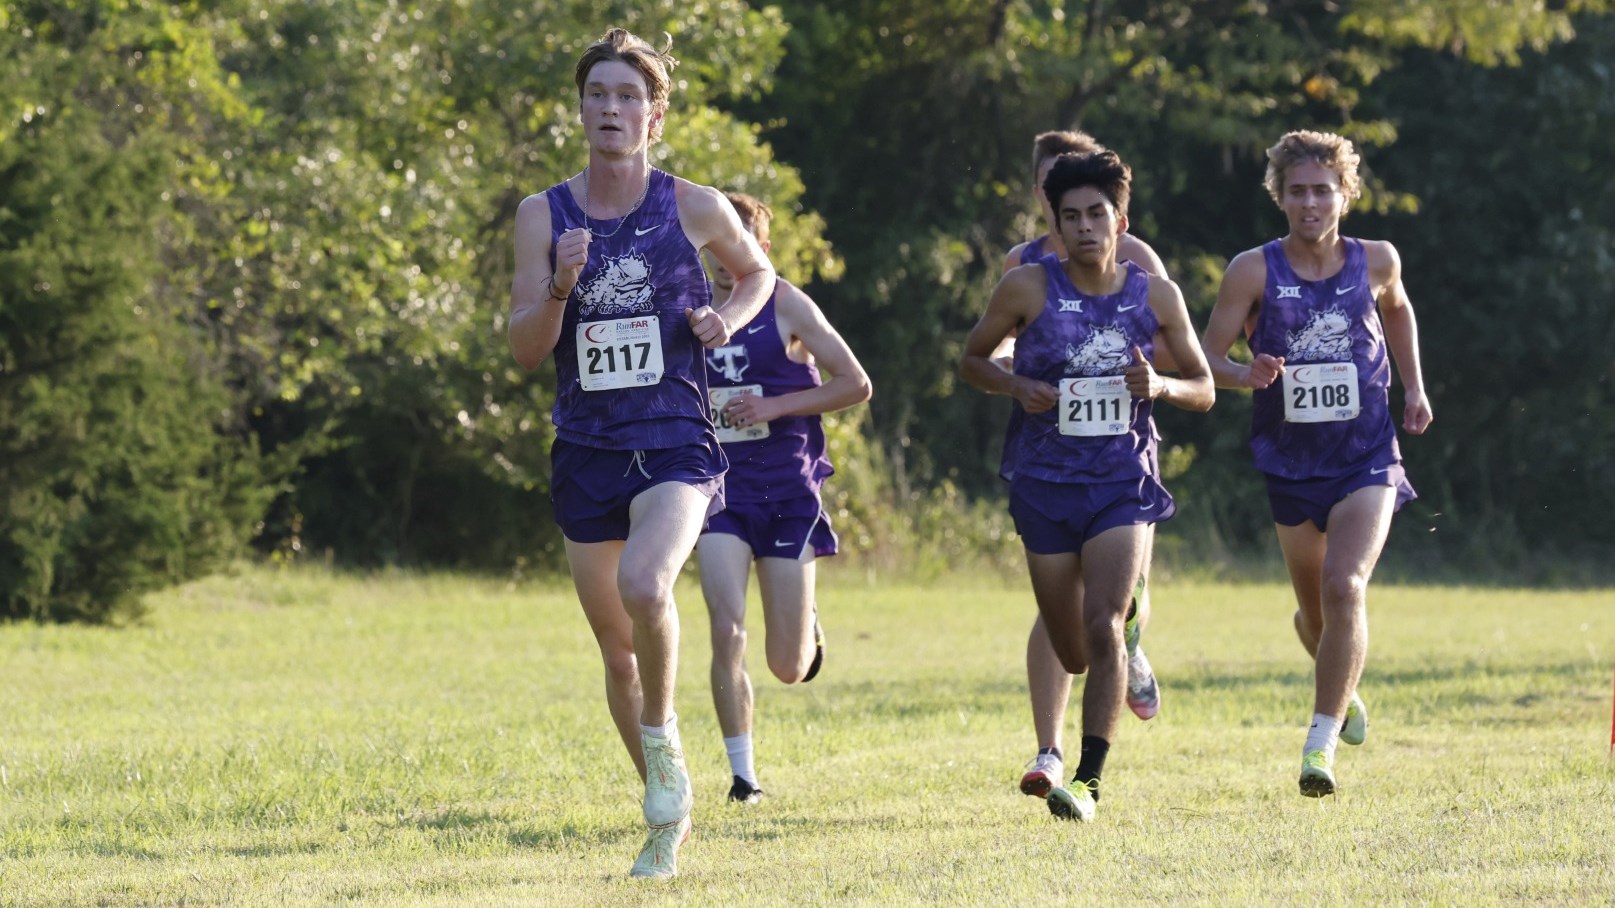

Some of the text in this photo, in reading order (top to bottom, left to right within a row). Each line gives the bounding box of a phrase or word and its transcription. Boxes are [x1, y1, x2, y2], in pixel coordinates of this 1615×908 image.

[616, 320, 648, 330] RunFAR
[586, 342, 651, 375] 2117
[1293, 384, 1350, 409] 2108
[1068, 398, 1120, 422] 2111
